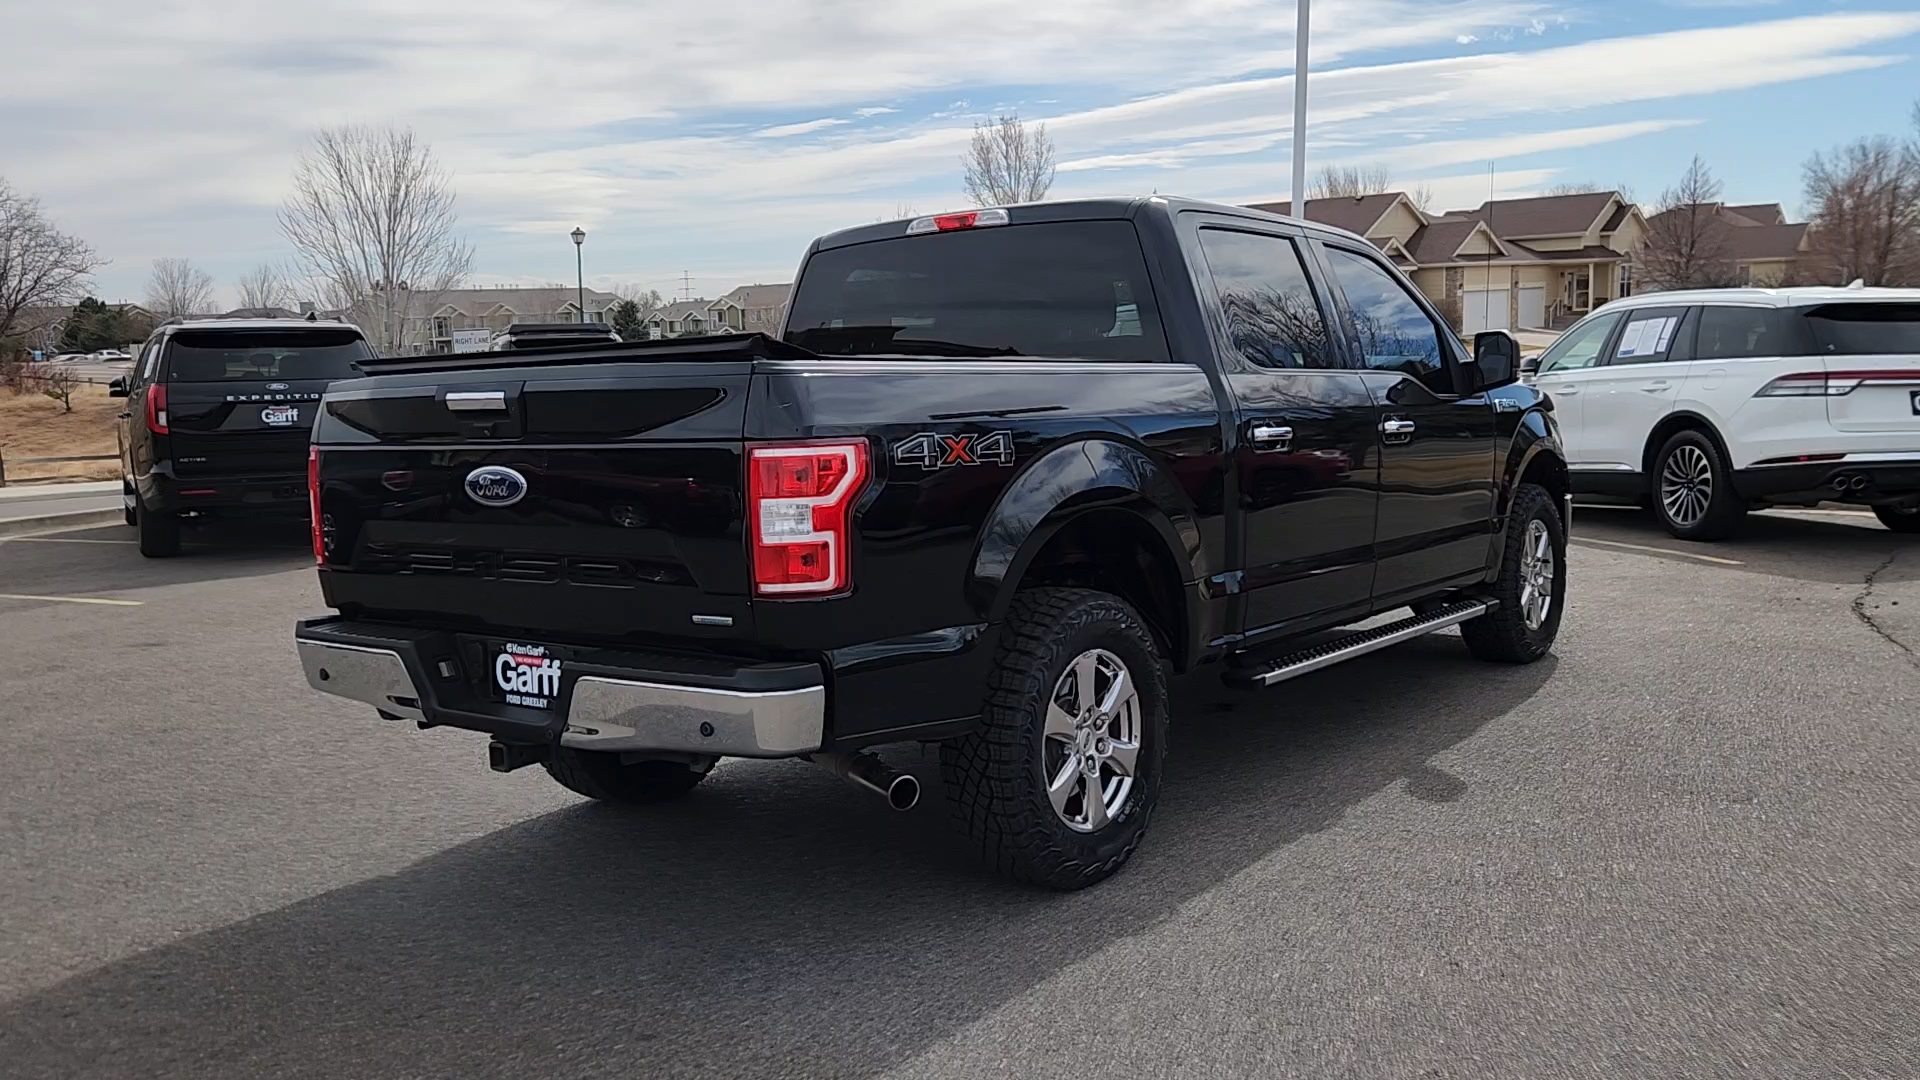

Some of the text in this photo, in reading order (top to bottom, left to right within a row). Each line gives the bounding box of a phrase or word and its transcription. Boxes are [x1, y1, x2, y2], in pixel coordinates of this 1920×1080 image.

[455, 336, 490, 345] RIGHT LANE
[261, 407, 298, 423] Garff
[476, 474, 510, 497] Ford
[527, 645, 545, 656] Garff
[496, 653, 561, 697] Garff
[506, 694, 548, 708] FORD GREELEY
